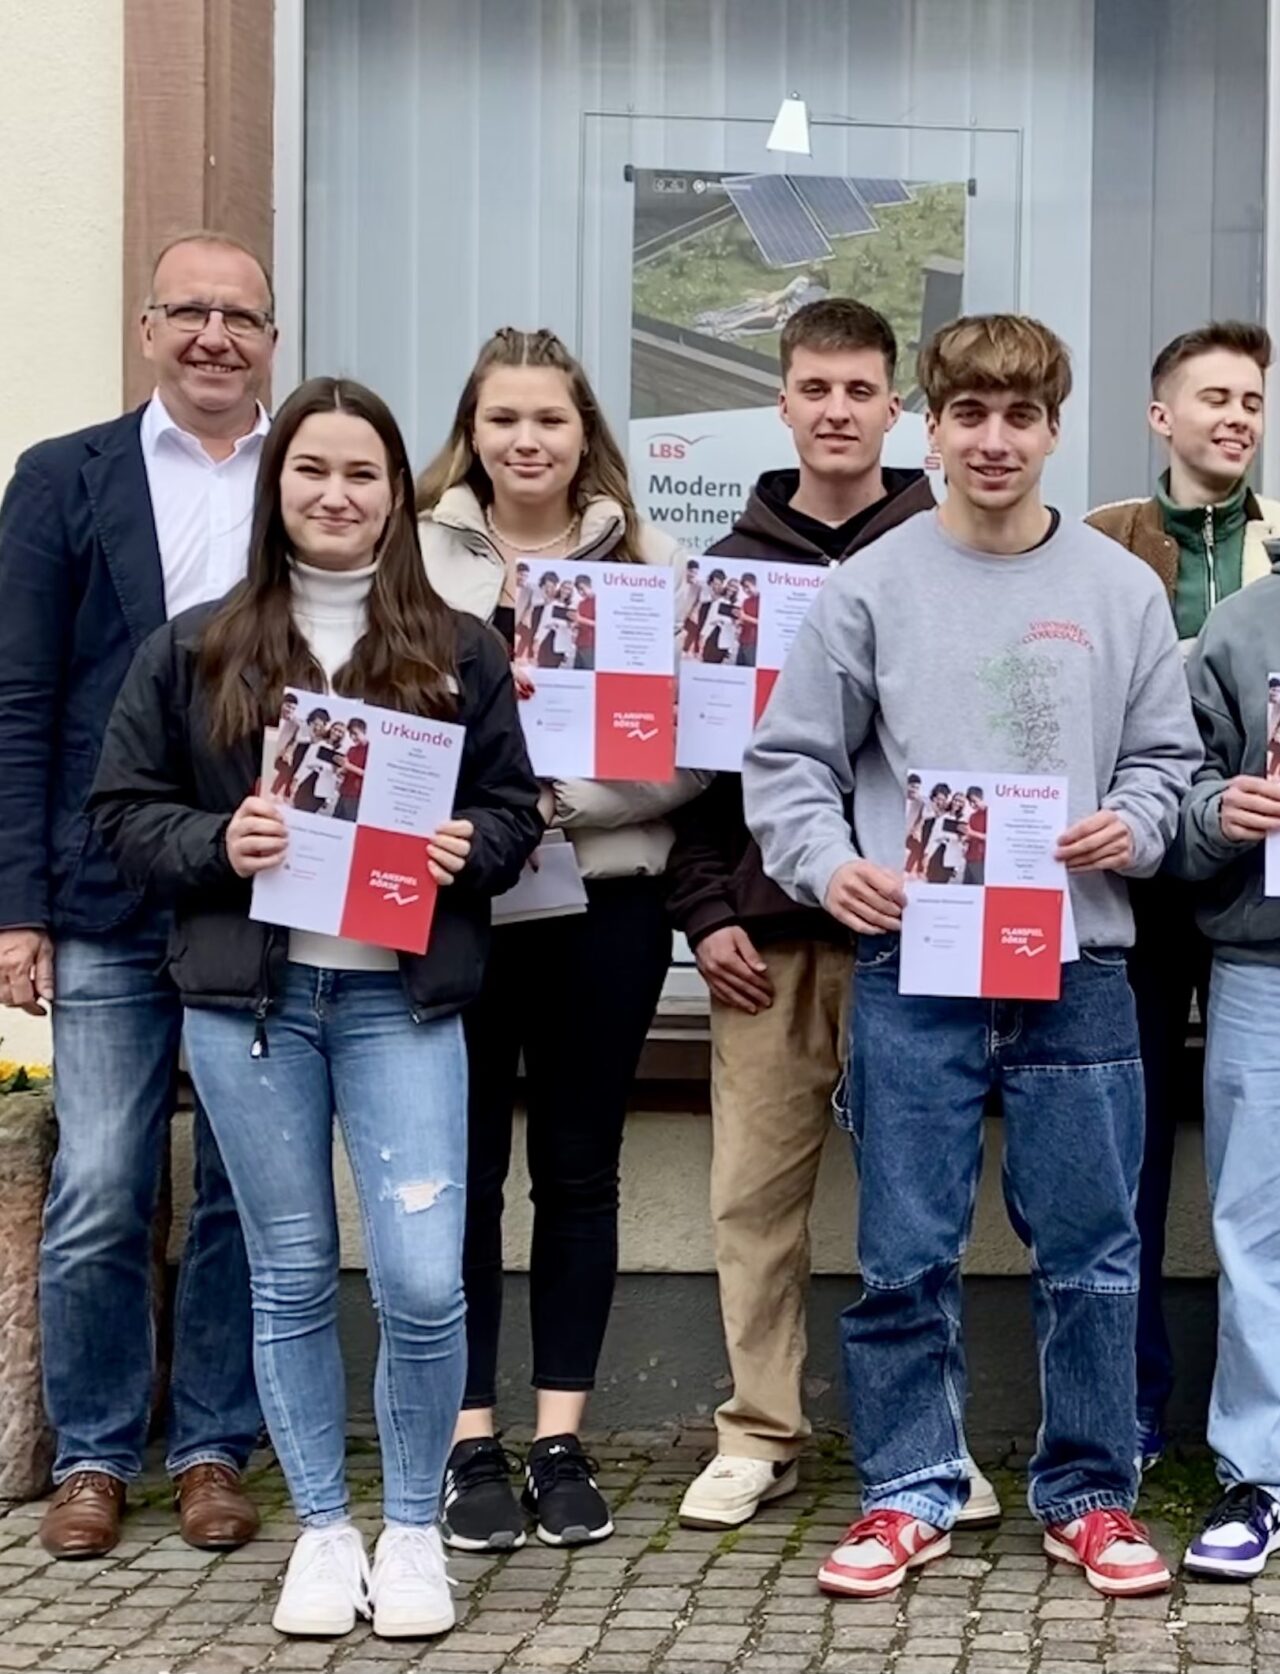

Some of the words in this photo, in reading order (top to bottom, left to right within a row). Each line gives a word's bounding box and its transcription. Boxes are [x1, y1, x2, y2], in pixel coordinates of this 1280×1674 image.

[649, 443, 686, 459] LBS
[649, 474, 742, 497] Modern
[603, 572, 667, 589] Urkunde
[768, 572, 824, 588] Urkund
[381, 720, 453, 748] Urkunde
[995, 784, 1060, 800] Urkunde
